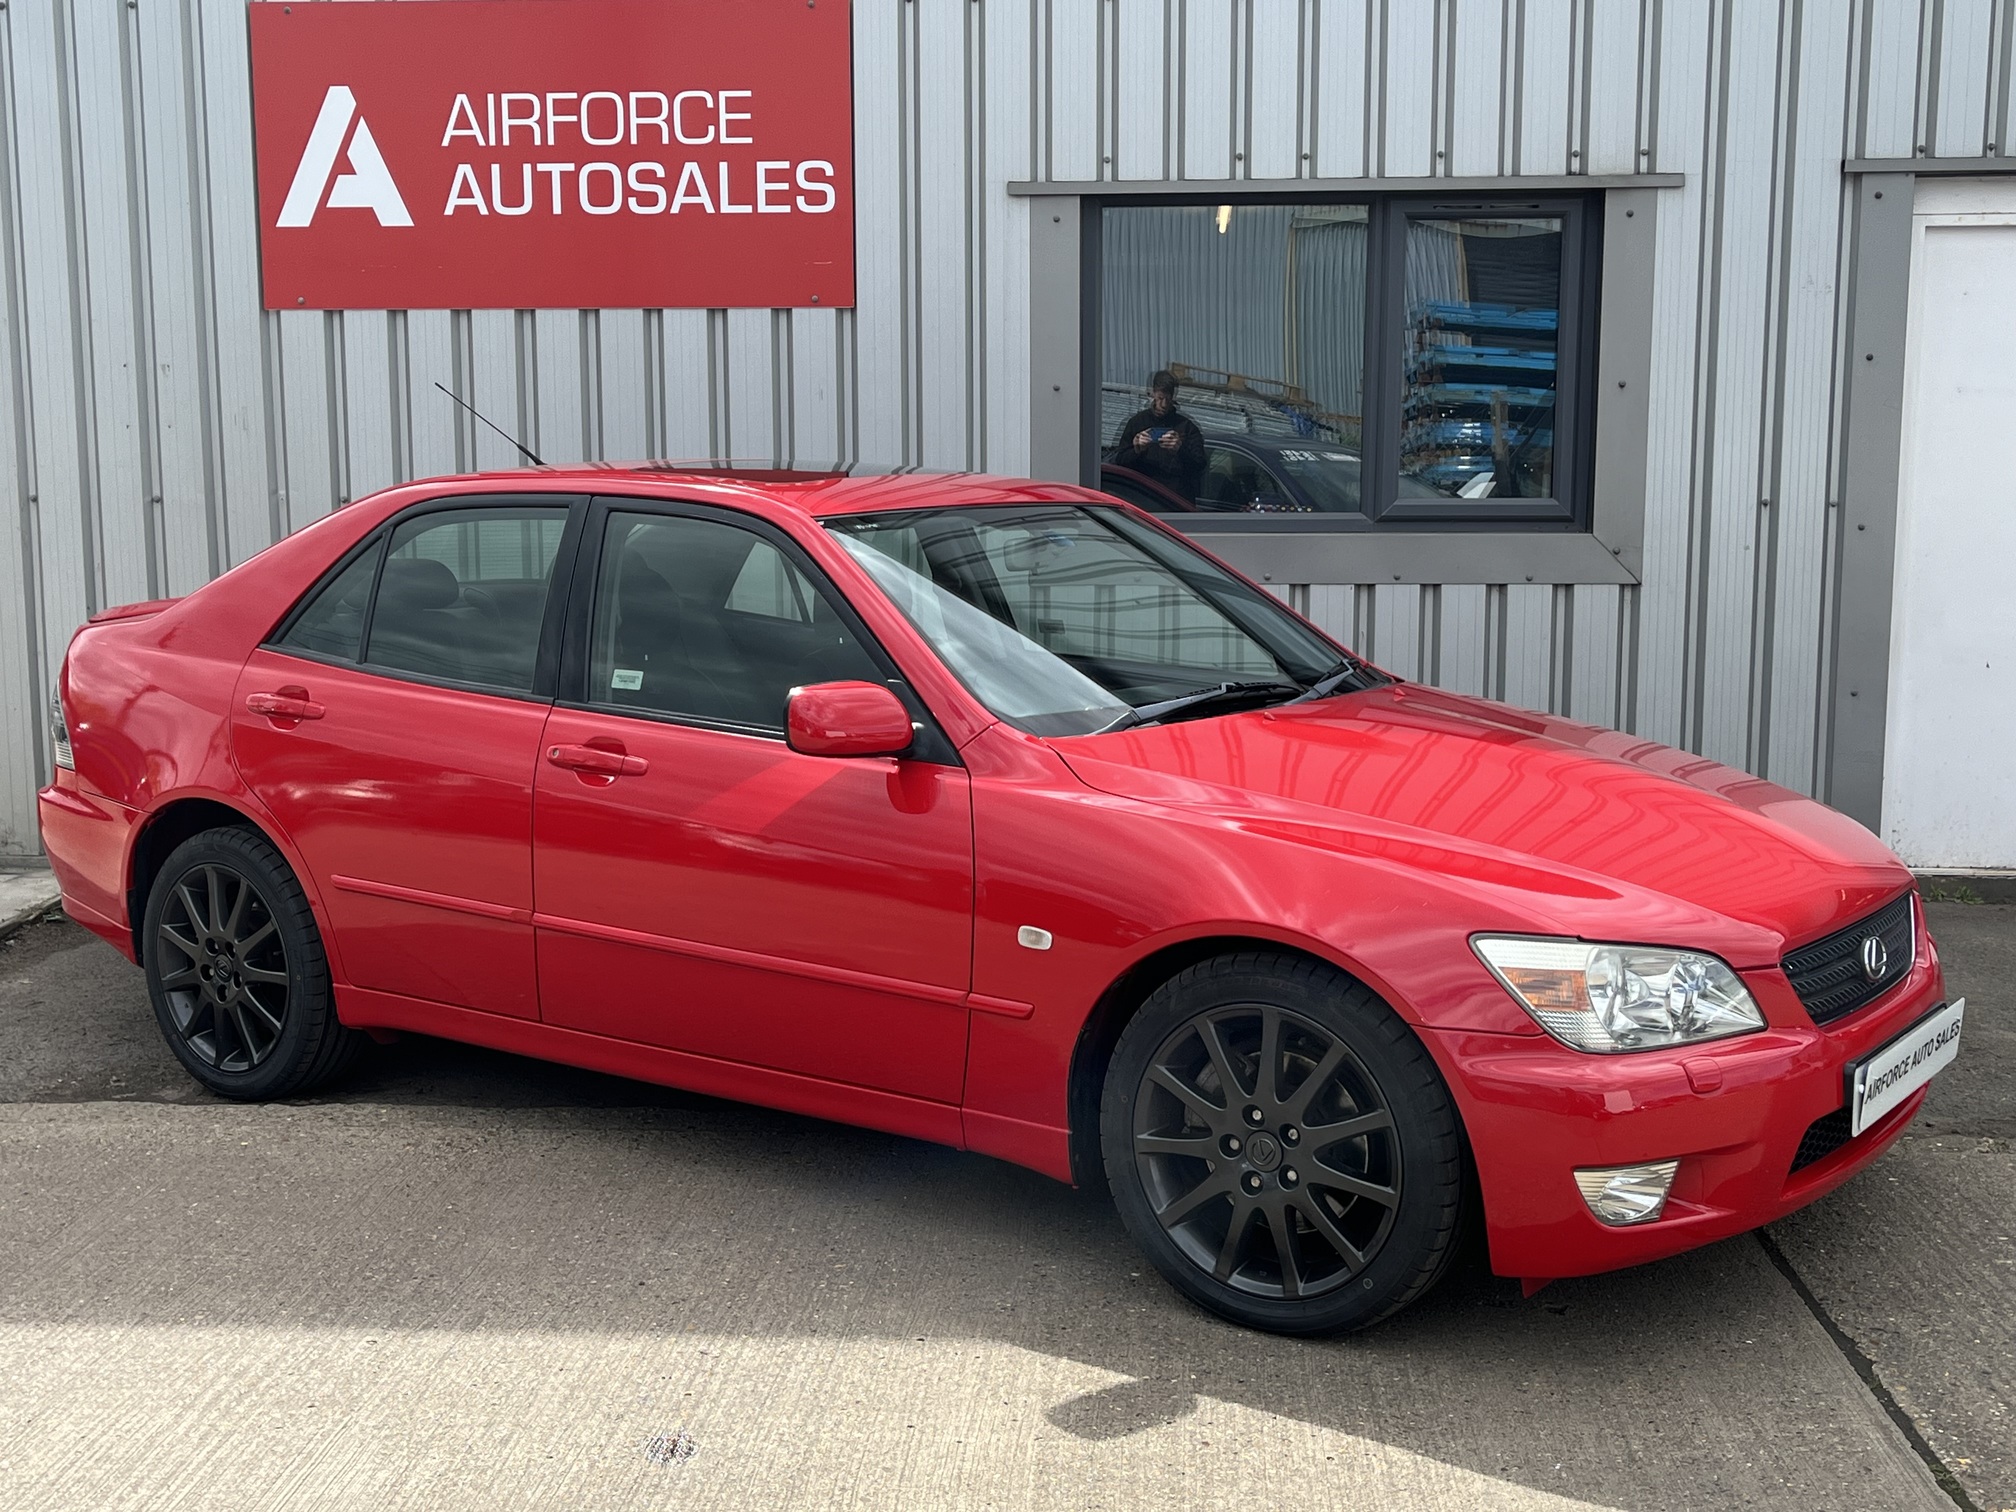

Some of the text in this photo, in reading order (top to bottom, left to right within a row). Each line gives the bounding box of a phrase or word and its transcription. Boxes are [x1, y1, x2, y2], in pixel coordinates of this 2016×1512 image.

[441, 90, 754, 147] AIRFORCE
[276, 85, 415, 227] A
[443, 160, 837, 216] AUTOSALES
[1864, 1019, 1961, 1104] AIRFORCE AUTO SALES
